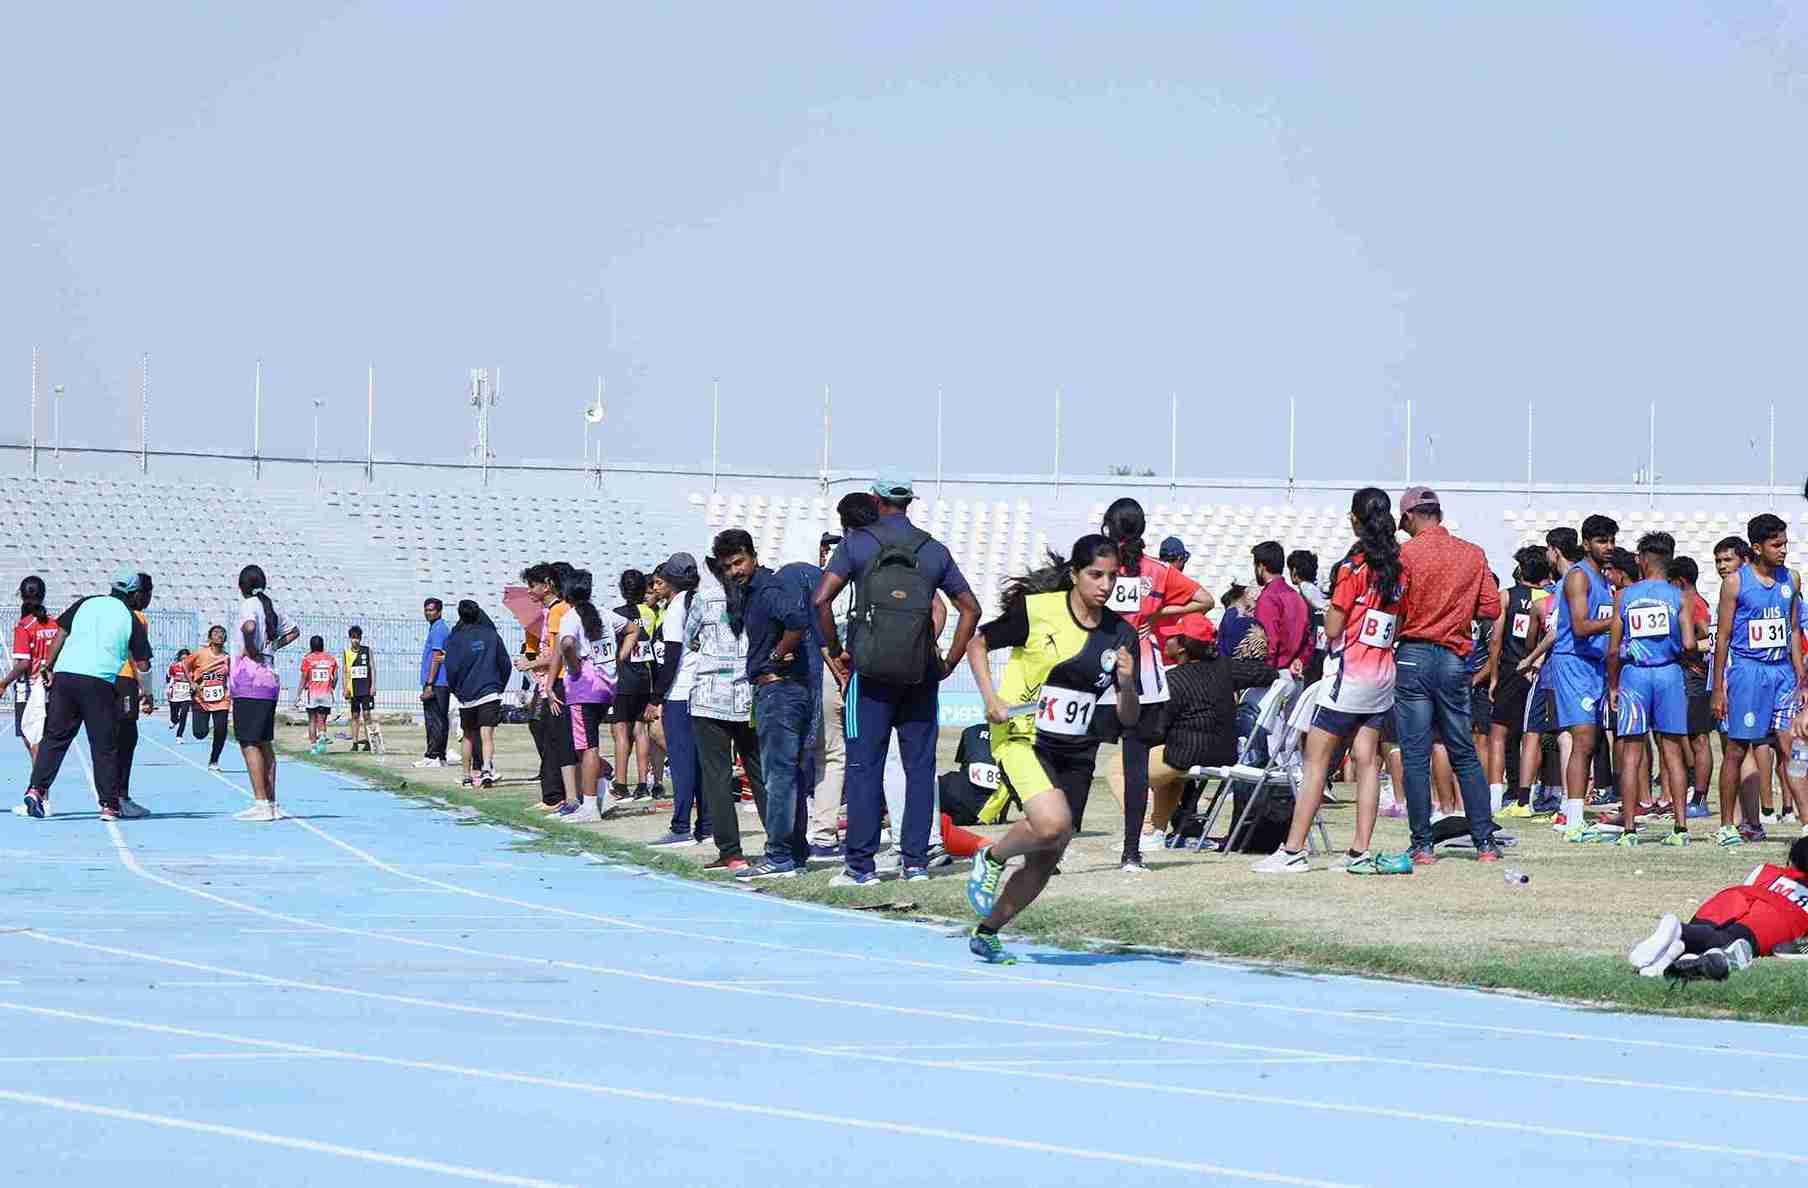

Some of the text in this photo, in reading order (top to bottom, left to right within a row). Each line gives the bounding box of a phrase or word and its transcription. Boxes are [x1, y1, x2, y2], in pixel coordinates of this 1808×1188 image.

[1116, 585, 1138, 603] 84
[1763, 607, 1780, 618] UIS
[1366, 619, 1378, 636] B
[1514, 619, 1524, 632] K
[1631, 613, 1667, 630] U 32
[1751, 624, 1785, 642] U 31
[1039, 696, 1091, 725] K 91
[972, 767, 981, 782] K
